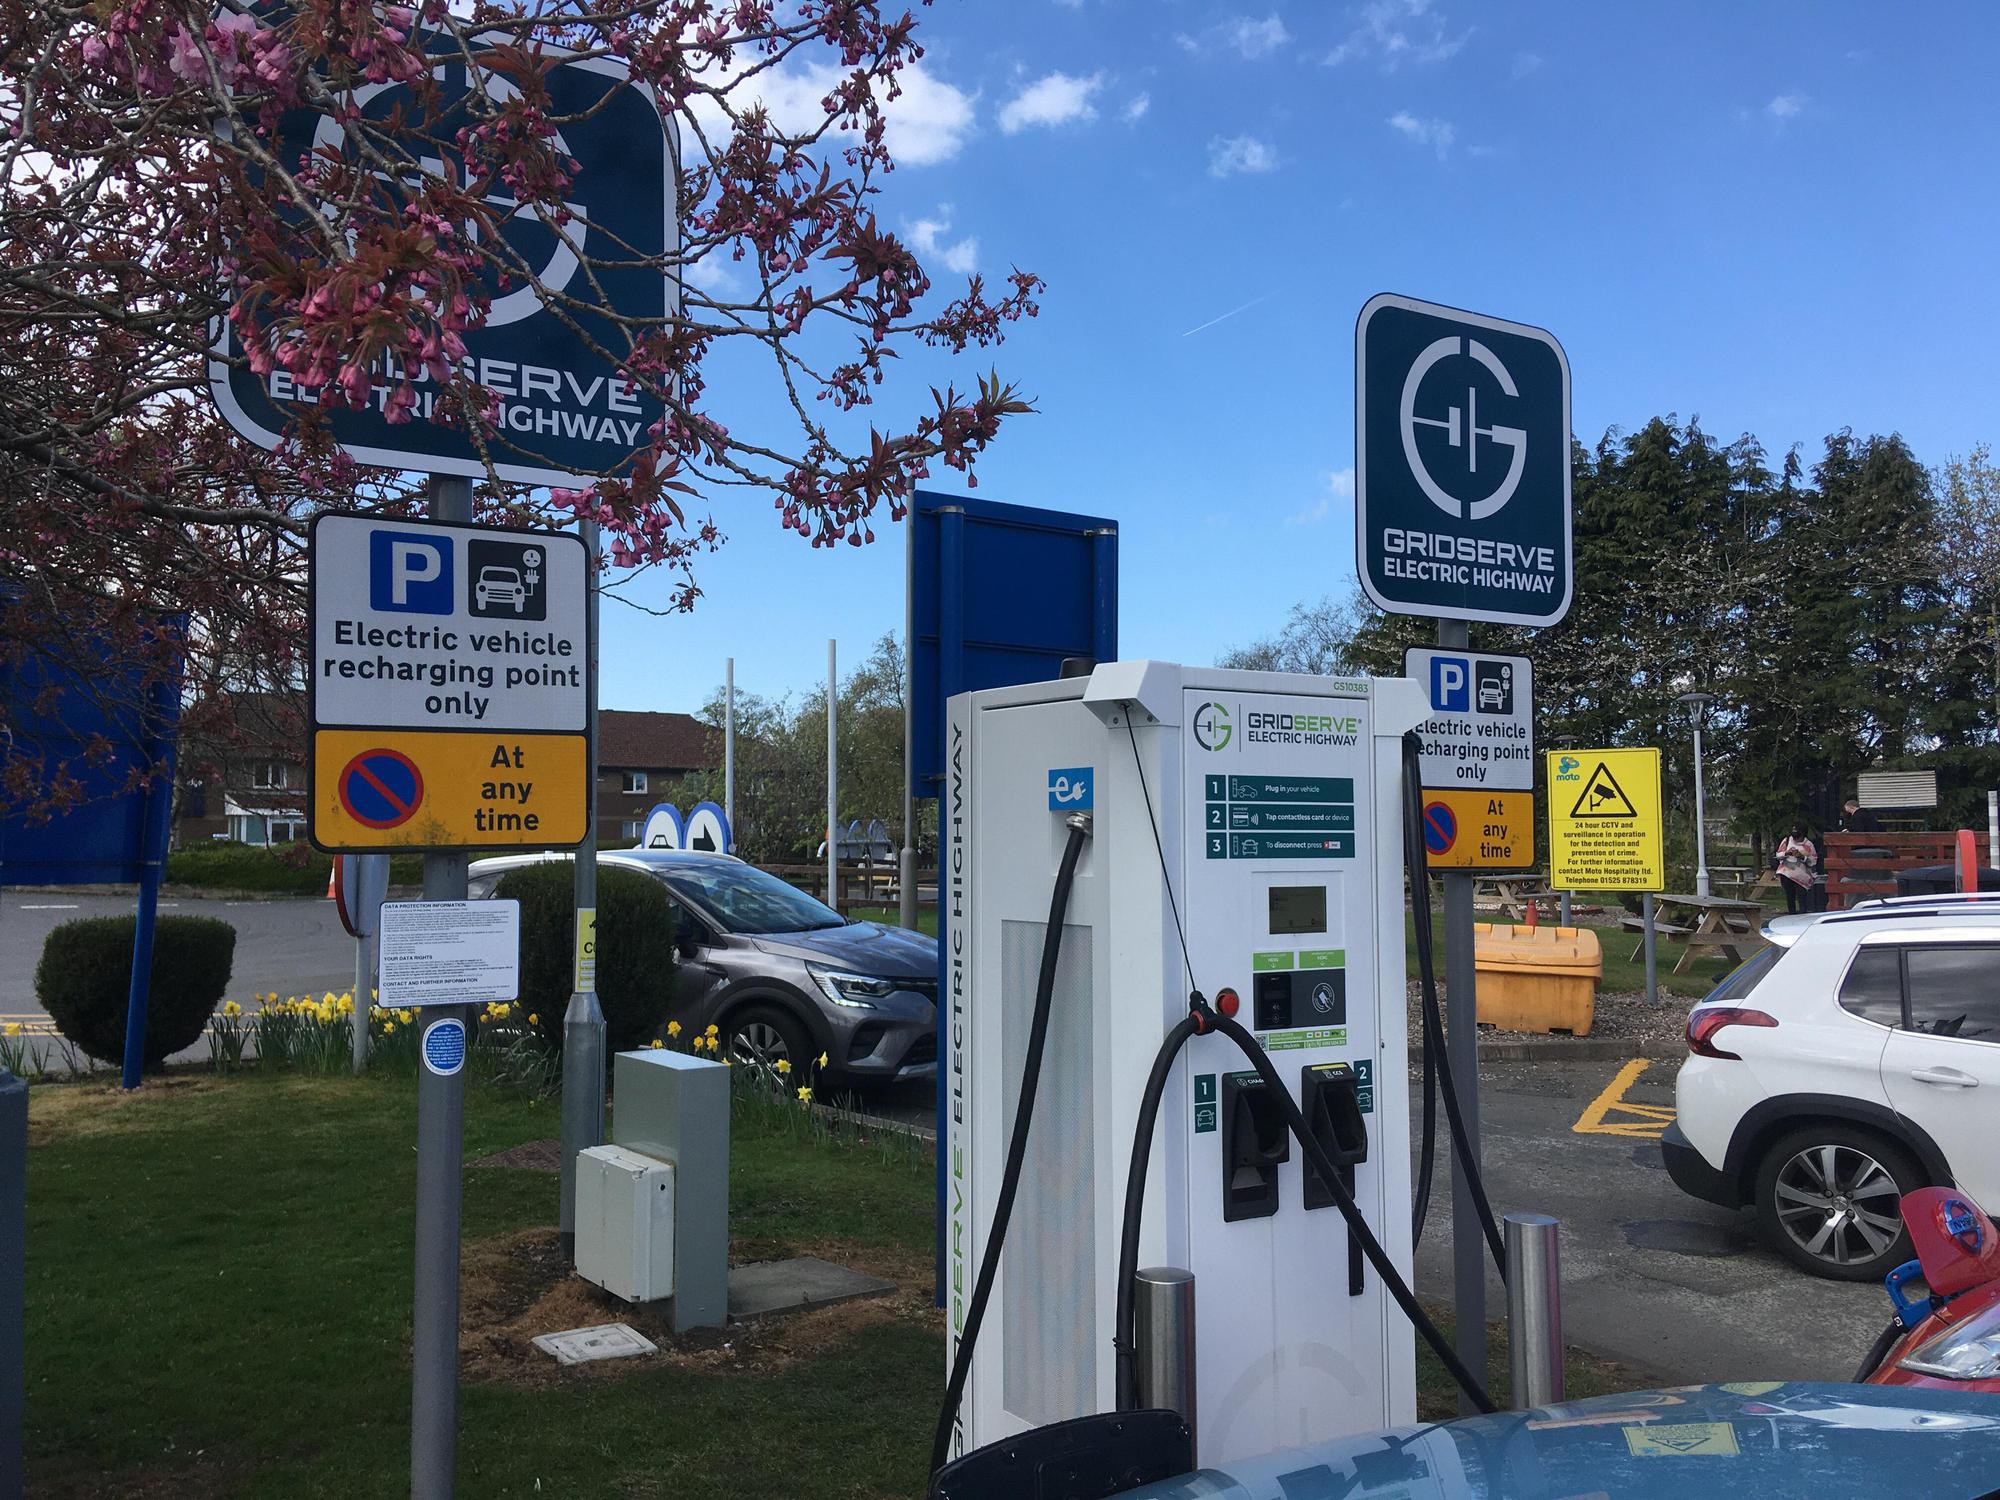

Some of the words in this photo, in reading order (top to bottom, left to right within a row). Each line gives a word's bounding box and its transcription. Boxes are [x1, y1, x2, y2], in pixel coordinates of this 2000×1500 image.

[484, 402, 642, 446] IGHWAY
[1383, 527, 1555, 572] GRIDSERVE
[392, 541, 441, 605] P
[1384, 556, 1470, 585] ELECTRIC
[1473, 567, 1555, 594] HIGHWAY
[335, 620, 458, 651] Electric
[469, 630, 573, 656] vehicle
[324, 655, 494, 689] recharging
[505, 663, 580, 689] point
[1334, 682, 1369, 693] GS10383
[1439, 663, 1464, 706] P
[425, 691, 490, 720] only
[1248, 713, 1357, 733] GRIDSERVE
[1476, 721, 1526, 739] vehicle
[1248, 730, 1302, 744] ELECTRIC
[1304, 733, 1358, 746] HIGHWAY
[490, 744, 525, 769] At
[1418, 740, 1489, 761] echarging
[1493, 744, 1530, 761] point
[1456, 762, 1487, 782] only
[1556, 773, 1580, 781] moto
[481, 781, 533, 805] any
[1212, 781, 1218, 794] 1
[1265, 785, 1279, 793] Plug
[1487, 799, 1504, 816] At
[474, 808, 540, 832] time
[953, 721, 963, 917] HIGHWAY
[1212, 810, 1221, 823] 2
[1265, 813, 1277, 822] Tap
[1601, 821, 1619, 829] CCTV
[1621, 821, 1633, 829] and
[1483, 823, 1508, 840] any
[1613, 831, 1646, 839] operation
[1212, 839, 1221, 852] 3
[1274, 841, 1307, 849] disconnect
[1480, 842, 1511, 858] time
[1603, 867, 1640, 876] Hospitality
[953, 928, 963, 1126] ELECTRIC
[1359, 1066, 1367, 1079] 2
[1201, 1081, 1207, 1095] 1
